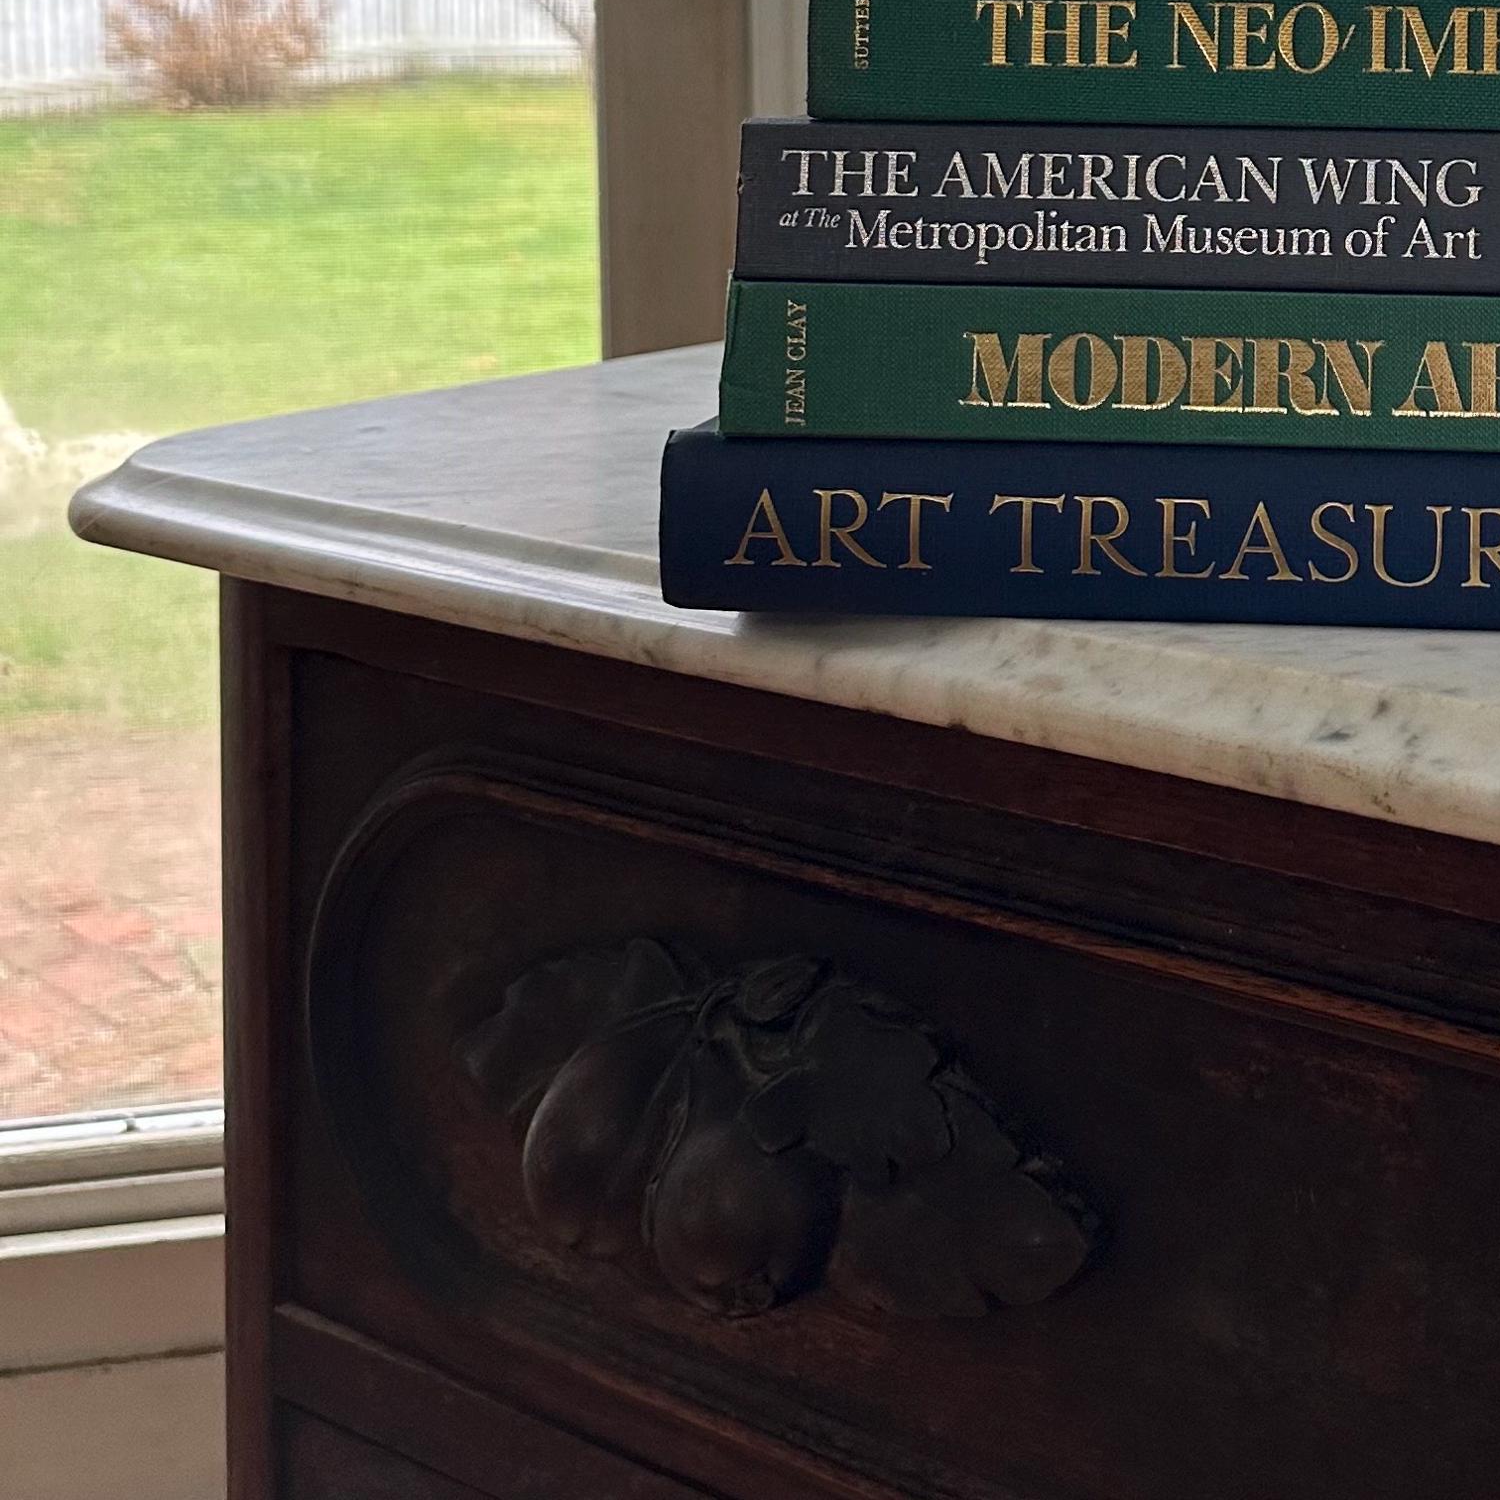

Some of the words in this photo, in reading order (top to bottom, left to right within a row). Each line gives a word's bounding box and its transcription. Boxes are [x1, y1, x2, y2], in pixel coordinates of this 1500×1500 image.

[976, 0, 1137, 67] THE
[781, 150, 918, 197] THE
[932, 152, 1282, 204] AMERICAN
[1298, 158, 1482, 207] WING
[779, 211, 798, 227] at
[804, 208, 841, 228] The
[845, 210, 1127, 265] Metropolitan
[1143, 214, 1332, 256] Museum
[1345, 216, 1394, 257] of
[1402, 218, 1481, 259] Art
[787, 300, 806, 361] CLAY
[784, 369, 805, 426] JEAN
[958, 333, 1384, 417] MODERN
[724, 488, 954, 569] ART
